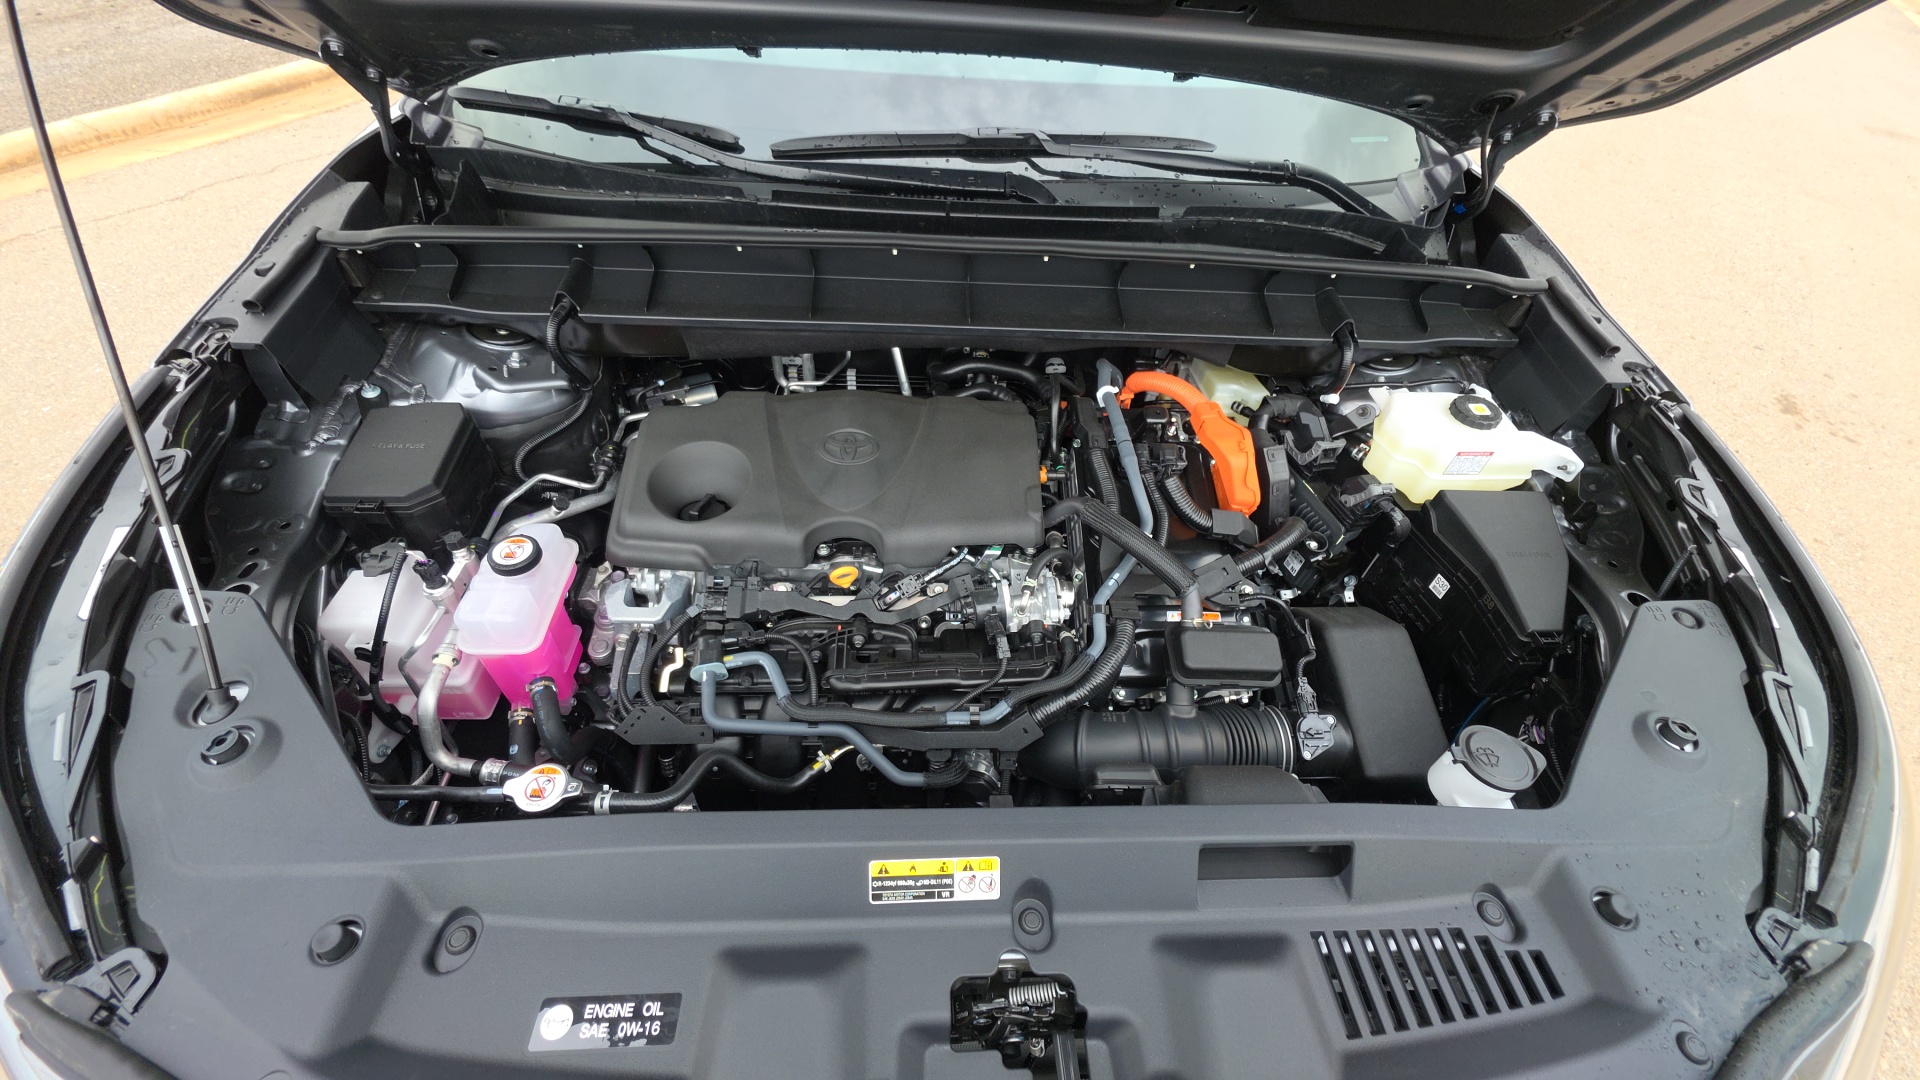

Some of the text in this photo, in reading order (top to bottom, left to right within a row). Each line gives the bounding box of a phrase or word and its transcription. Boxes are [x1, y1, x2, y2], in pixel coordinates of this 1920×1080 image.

[1434, 576, 1449, 592] S30
[584, 1001, 664, 1019] ENGINE OIL
[580, 1020, 661, 1039] SAE 0W-16
